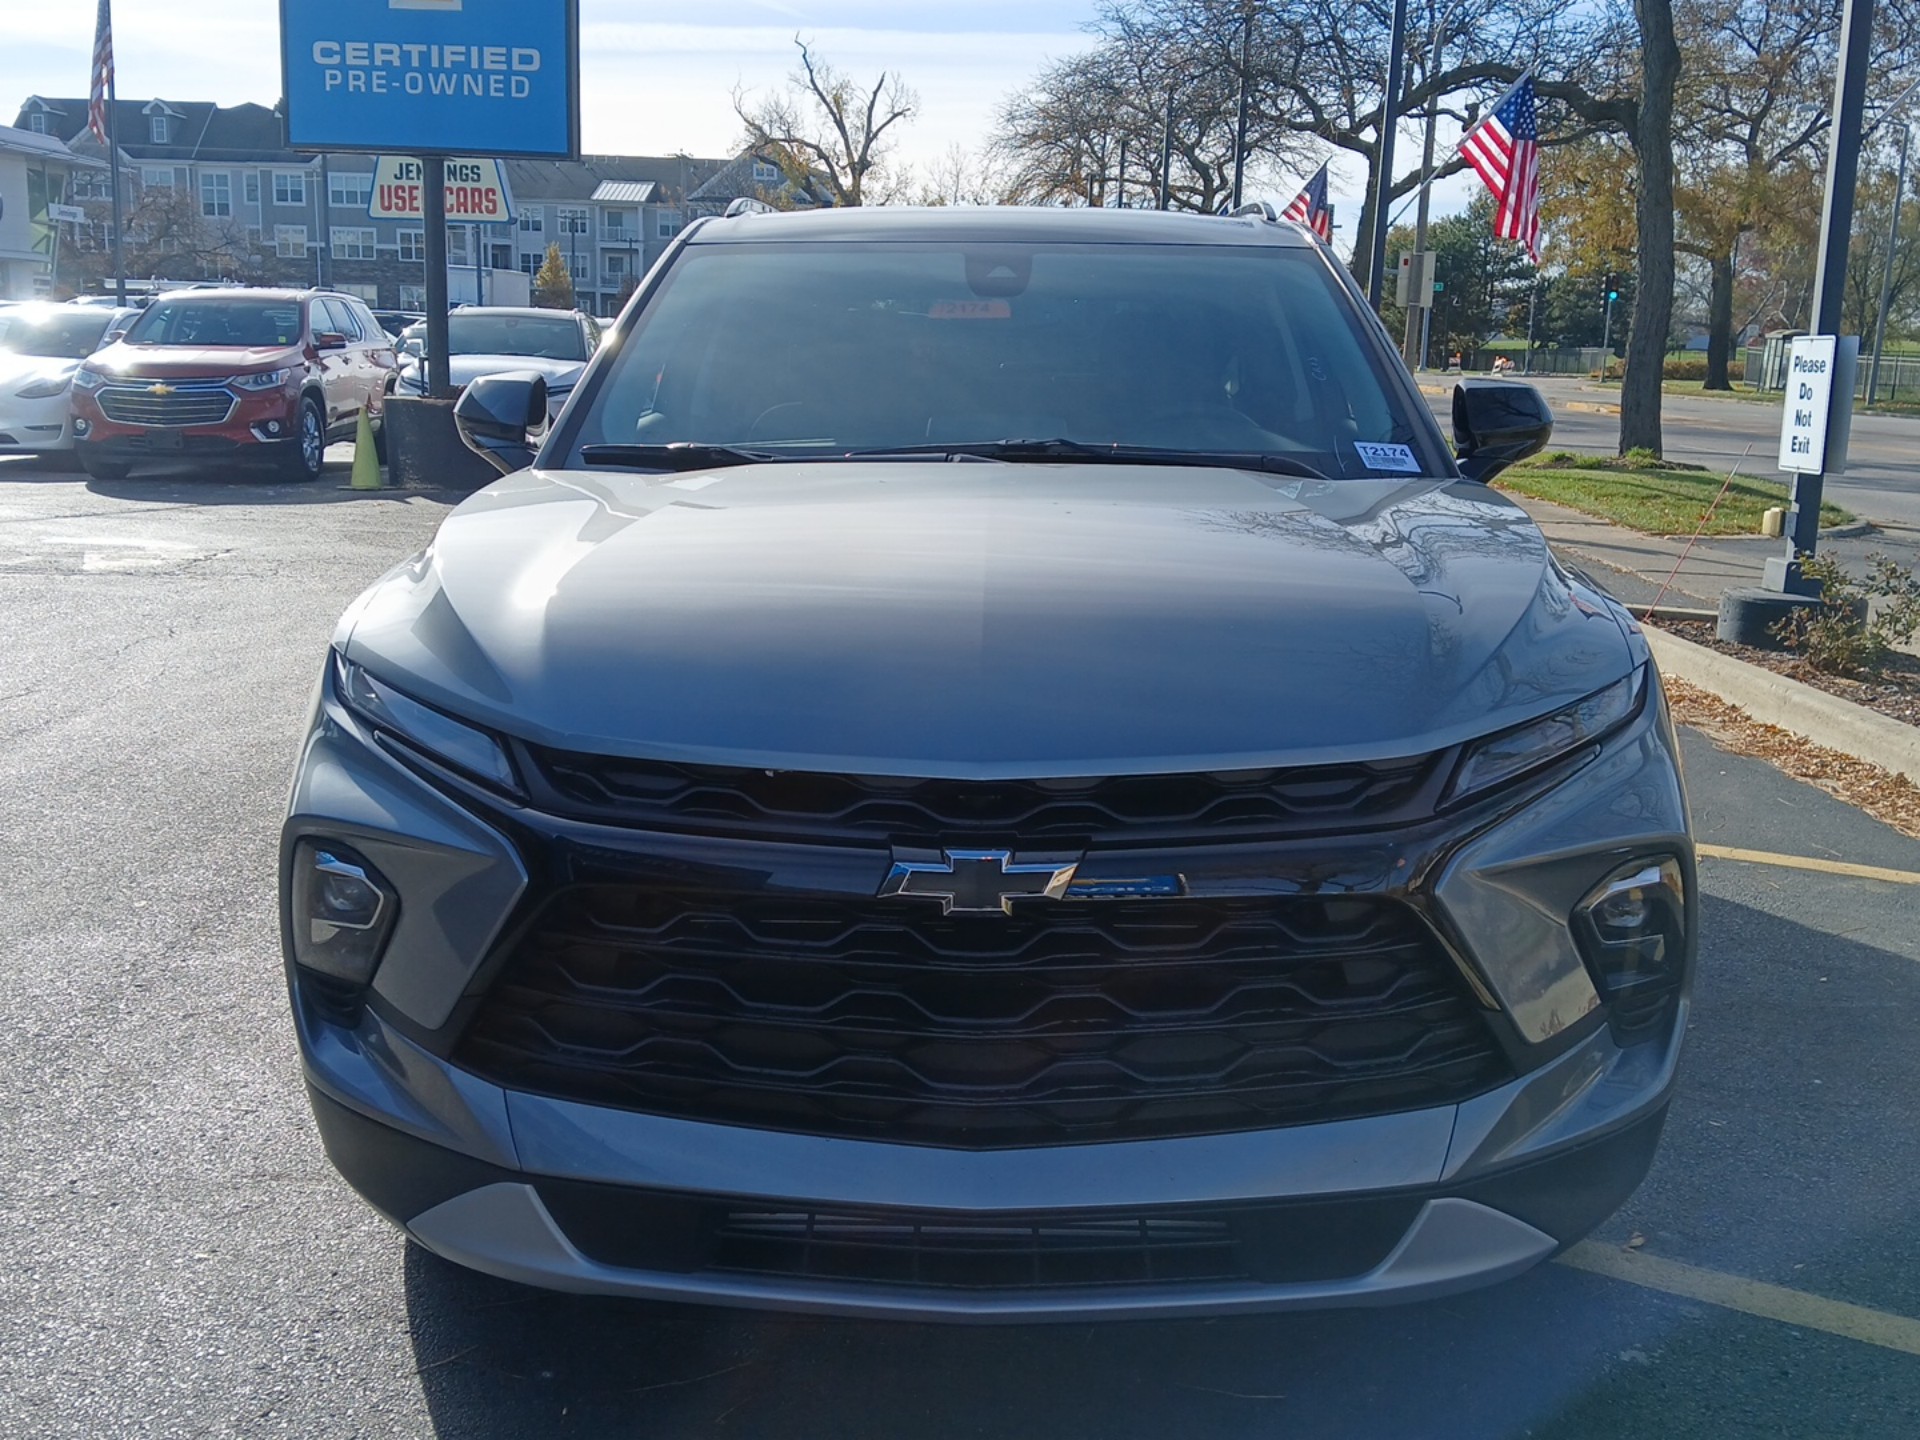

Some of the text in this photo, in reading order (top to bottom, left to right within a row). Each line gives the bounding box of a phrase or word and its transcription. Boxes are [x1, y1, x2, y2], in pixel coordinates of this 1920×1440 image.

[312, 41, 541, 72] CERTIFIED
[324, 69, 531, 98] PRE-OWNED
[380, 184, 498, 215] USE CARS
[1793, 355, 1827, 373] Please
[1799, 382, 1813, 400] Do
[1794, 408, 1812, 427] Not
[1359, 446, 1409, 458] T2174
[1791, 435, 1810, 454] Exit
